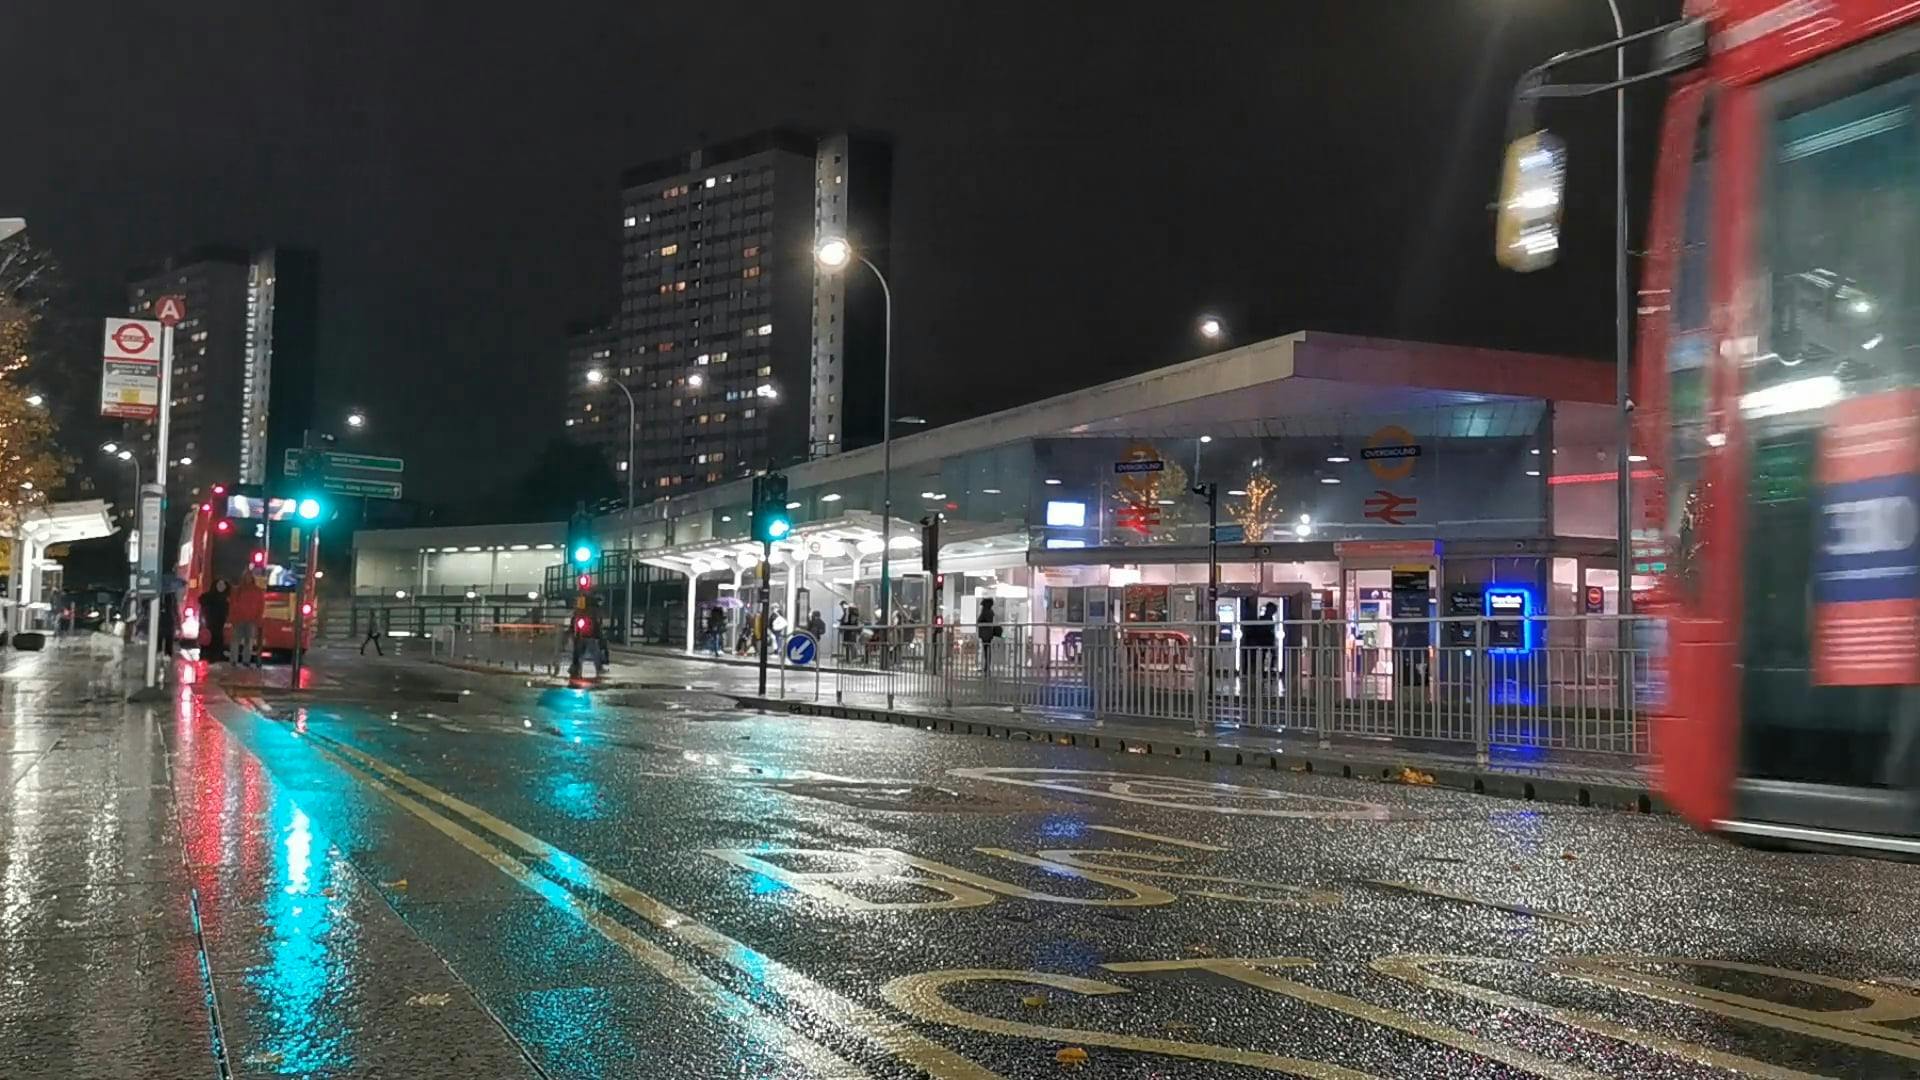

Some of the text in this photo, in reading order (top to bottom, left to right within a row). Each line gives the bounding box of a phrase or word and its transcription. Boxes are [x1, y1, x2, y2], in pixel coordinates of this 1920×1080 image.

[160, 299, 180, 320] A
[1364, 447, 1417, 459] OVERGROUND
[702, 847, 1344, 911] BUS
